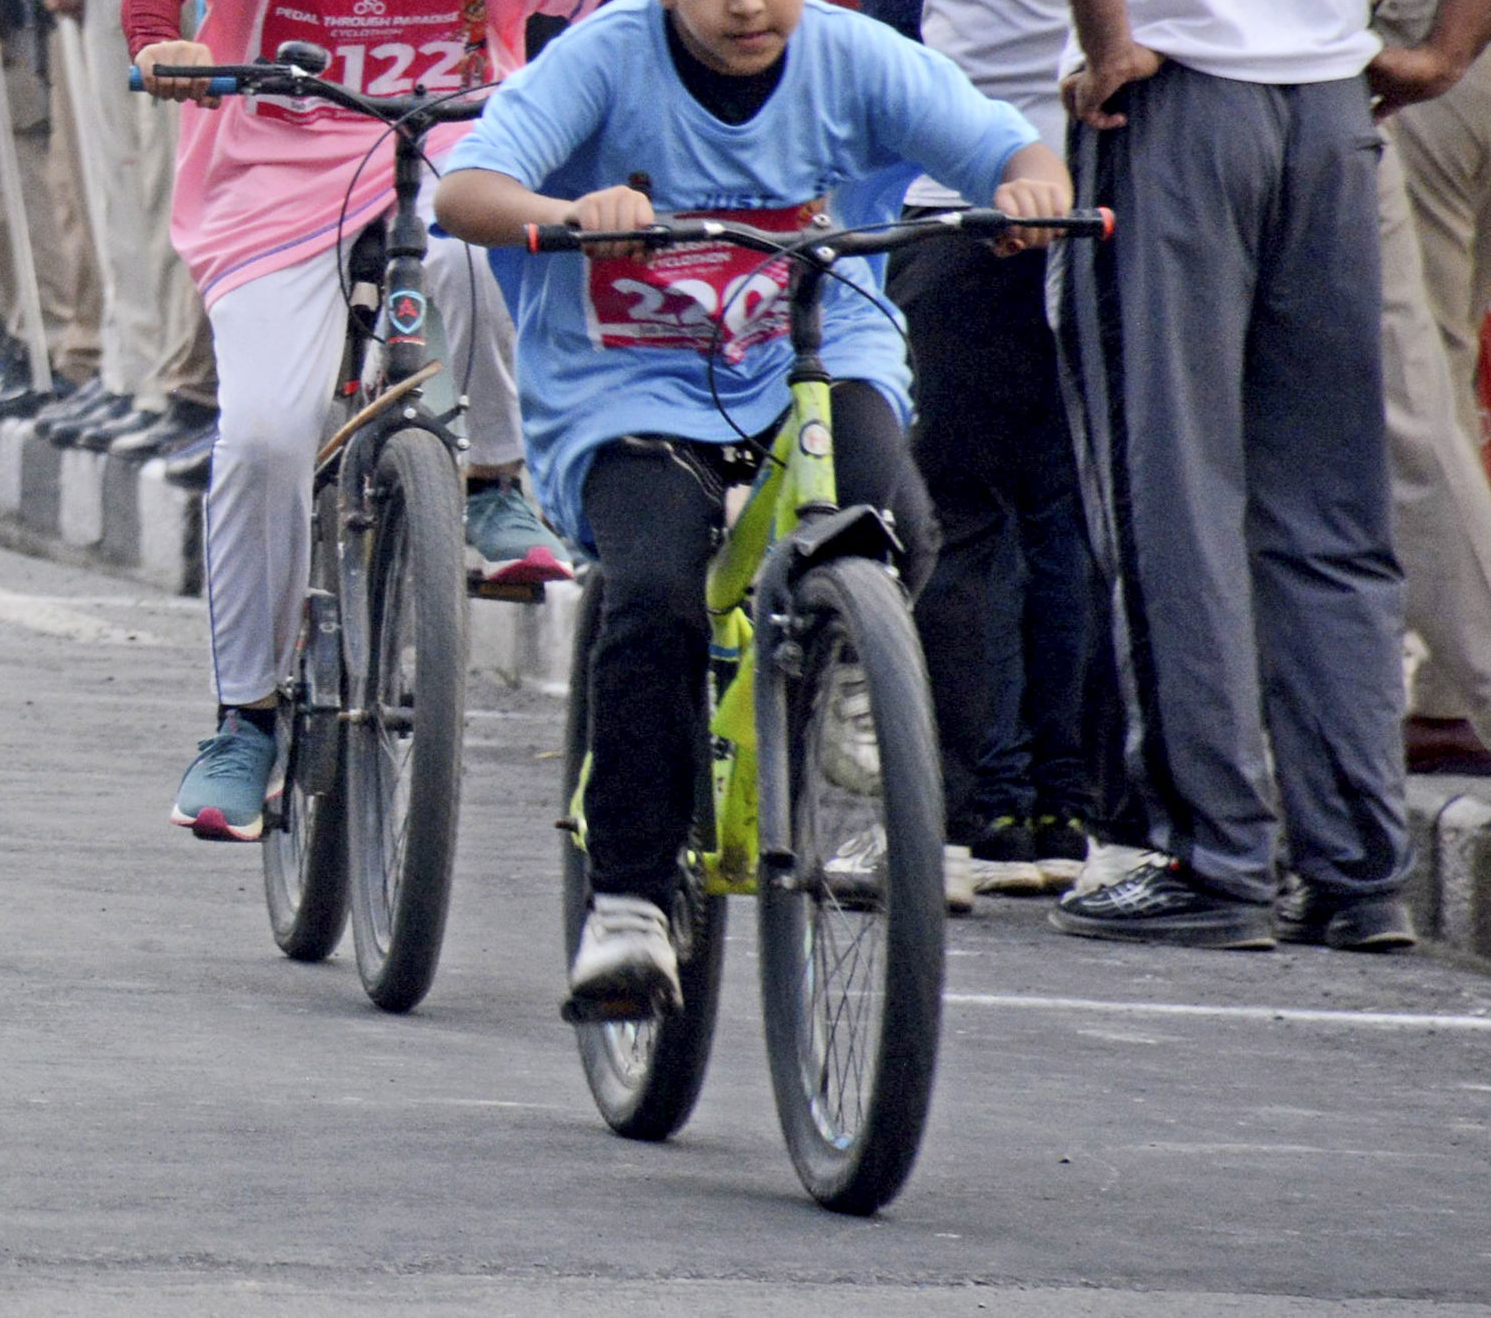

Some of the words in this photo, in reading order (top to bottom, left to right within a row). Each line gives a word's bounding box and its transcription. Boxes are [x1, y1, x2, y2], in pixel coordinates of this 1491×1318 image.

[274, 6, 320, 25] PEDAL
[323, 15, 392, 27] THROUGH
[392, 11, 461, 27] PARADISE
[330, 28, 404, 38] CYCLOTHON
[317, 40, 464, 96] 122
